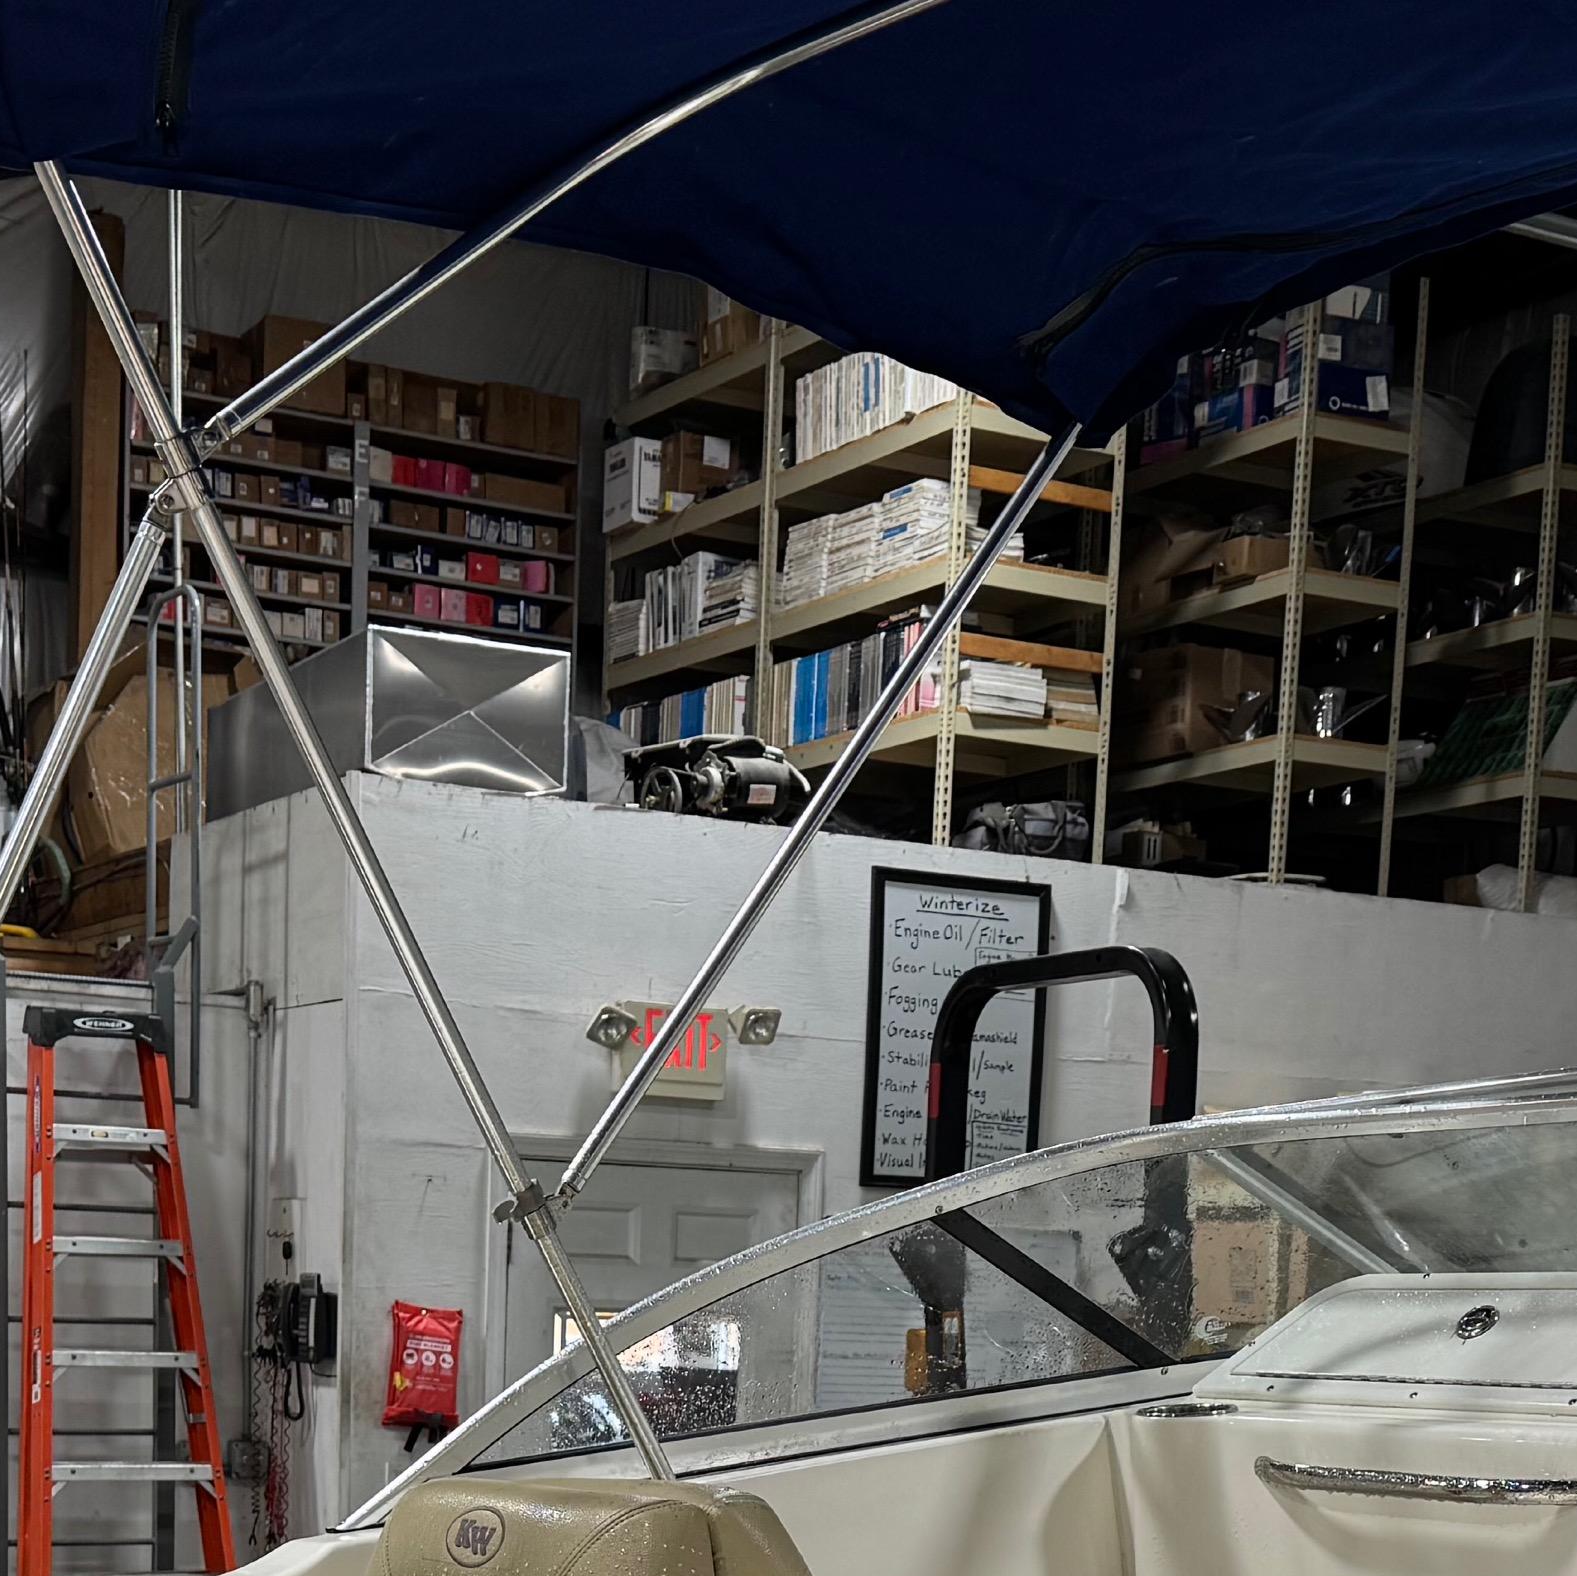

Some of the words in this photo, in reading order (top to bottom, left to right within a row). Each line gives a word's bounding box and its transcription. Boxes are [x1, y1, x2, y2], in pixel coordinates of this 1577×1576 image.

[919, 893, 1006, 917] Winterize
[894, 918, 940, 950] Engine
[943, 924, 963, 942] Oil
[979, 926, 1025, 945] Filter
[892, 956, 926, 974] Gear
[933, 962, 964, 979] Lub
[888, 985, 939, 1016] Fogging
[887, 1021, 934, 1039] Grease
[887, 1050, 929, 1068] Stabili
[883, 1078, 918, 1094] Paint
[883, 1104, 923, 1125] Engine
[881, 1133, 906, 1146] Wax
[880, 1152, 914, 1168] Visual
[455, 1518, 497, 1557] KW
